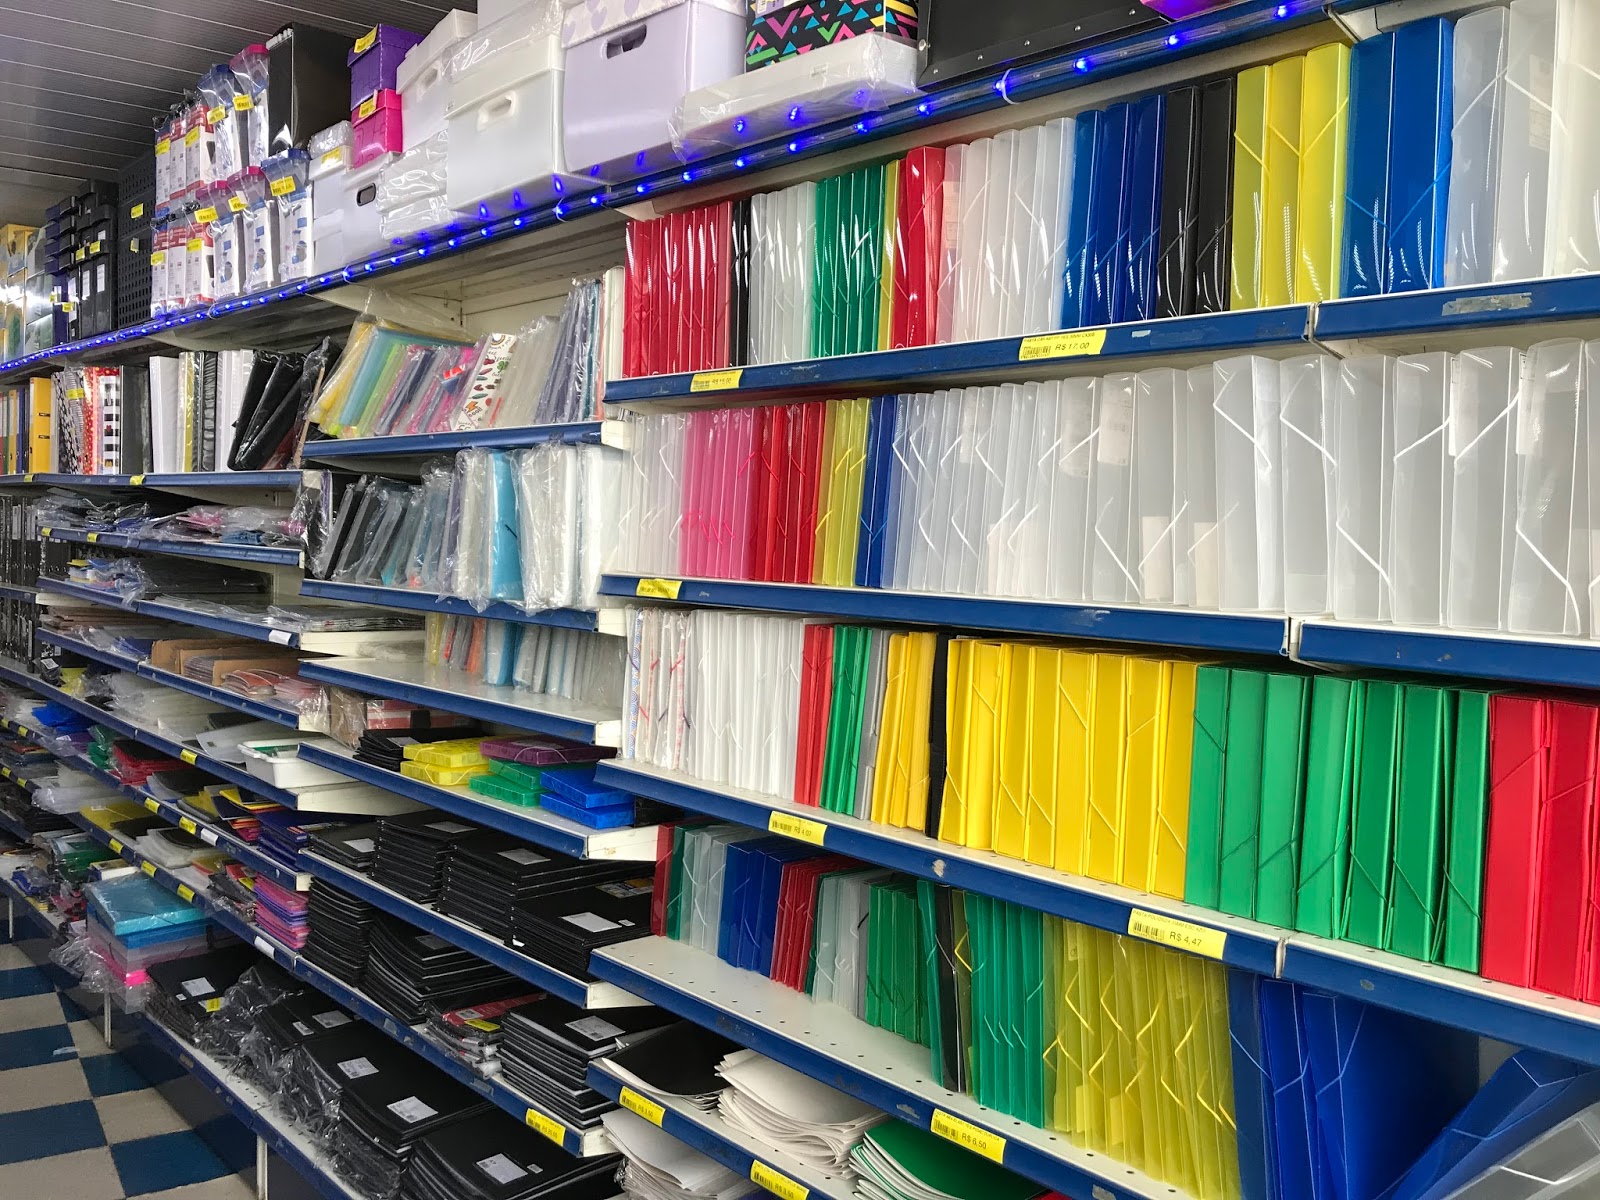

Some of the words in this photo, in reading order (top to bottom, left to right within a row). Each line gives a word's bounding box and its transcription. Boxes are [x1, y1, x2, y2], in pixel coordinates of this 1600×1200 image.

[1054, 343, 1067, 351] R$
[1133, 910, 1147, 918] PASTA
[1169, 930, 1183, 942] R$
[1183, 935, 1202, 948] 4,47
[961, 1132, 971, 1143] R$
[972, 1137, 987, 1151] 6,50
